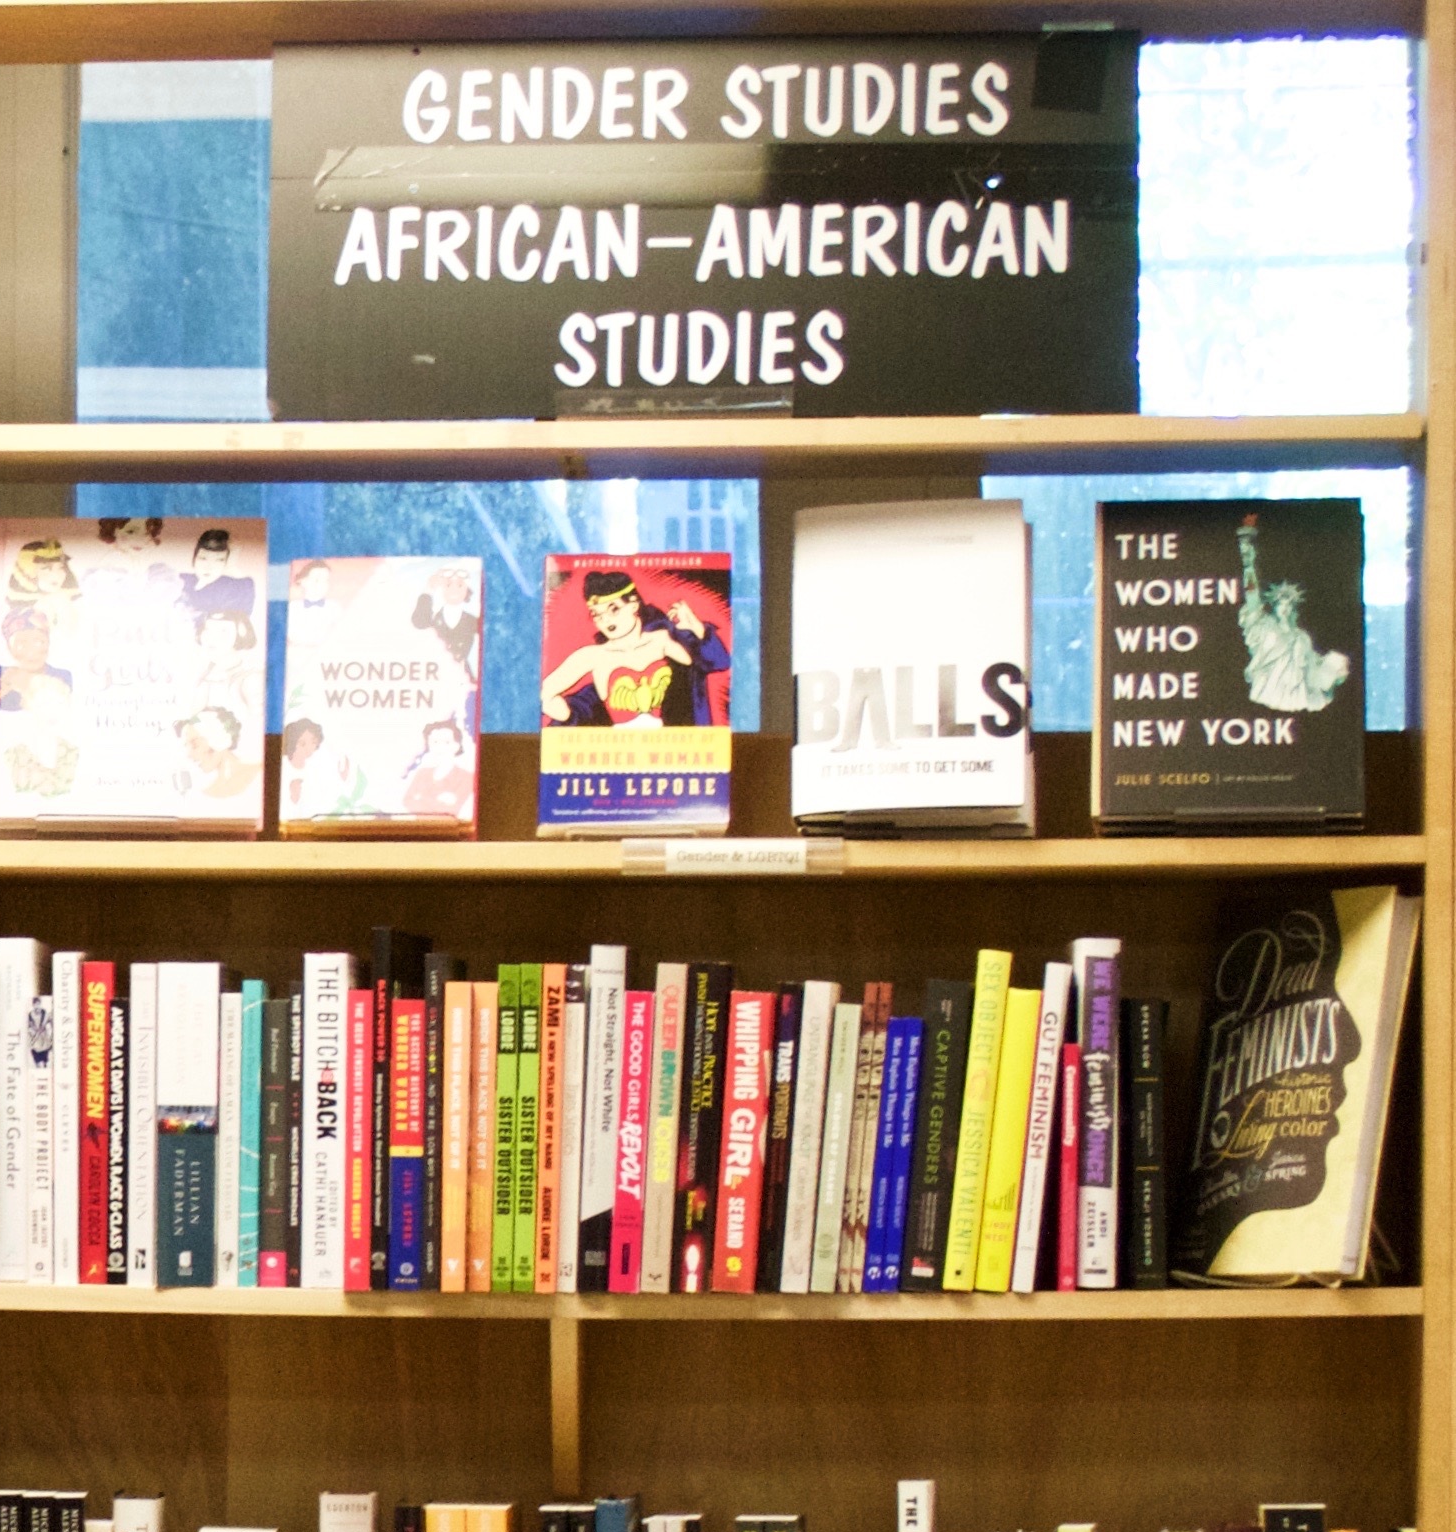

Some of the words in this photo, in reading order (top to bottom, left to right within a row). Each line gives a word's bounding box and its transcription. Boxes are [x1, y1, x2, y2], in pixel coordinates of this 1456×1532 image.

[402, 67, 689, 143] GENDER
[720, 62, 1009, 140] STUDIES
[334, 199, 1069, 285] AFRICAN-AMERICAN
[555, 310, 845, 387] STUDIES
[1115, 533, 1178, 560] THE
[1115, 578, 1237, 607] WOMEN
[1115, 625, 1198, 653] WHO
[320, 660, 439, 682] WONDER
[1113, 673, 1198, 699] MADE
[324, 689, 435, 709] WOMEN
[797, 661, 1026, 754] BALLS
[1113, 719, 1192, 746] NEW
[1201, 718, 1294, 746] YORK
[557, 774, 616, 796] JILL
[624, 775, 717, 796] LEPORE
[1115, 773, 1153, 785] JULIE
[319, 966, 339, 1007] THE
[547, 985, 561, 1029] ZAMI
[87, 981, 107, 1121] SUPERWOMEN
[318, 1013, 339, 1071] BITCH
[735, 1001, 760, 1101] WHIPPING
[1207, 998, 1340, 1108] FEMINISTS
[317, 1080, 338, 1140] BACK
[497, 1096, 511, 1146] SISTER
[726, 1108, 754, 1185] GIRL
[497, 1149, 511, 1216] OUTSIDER
